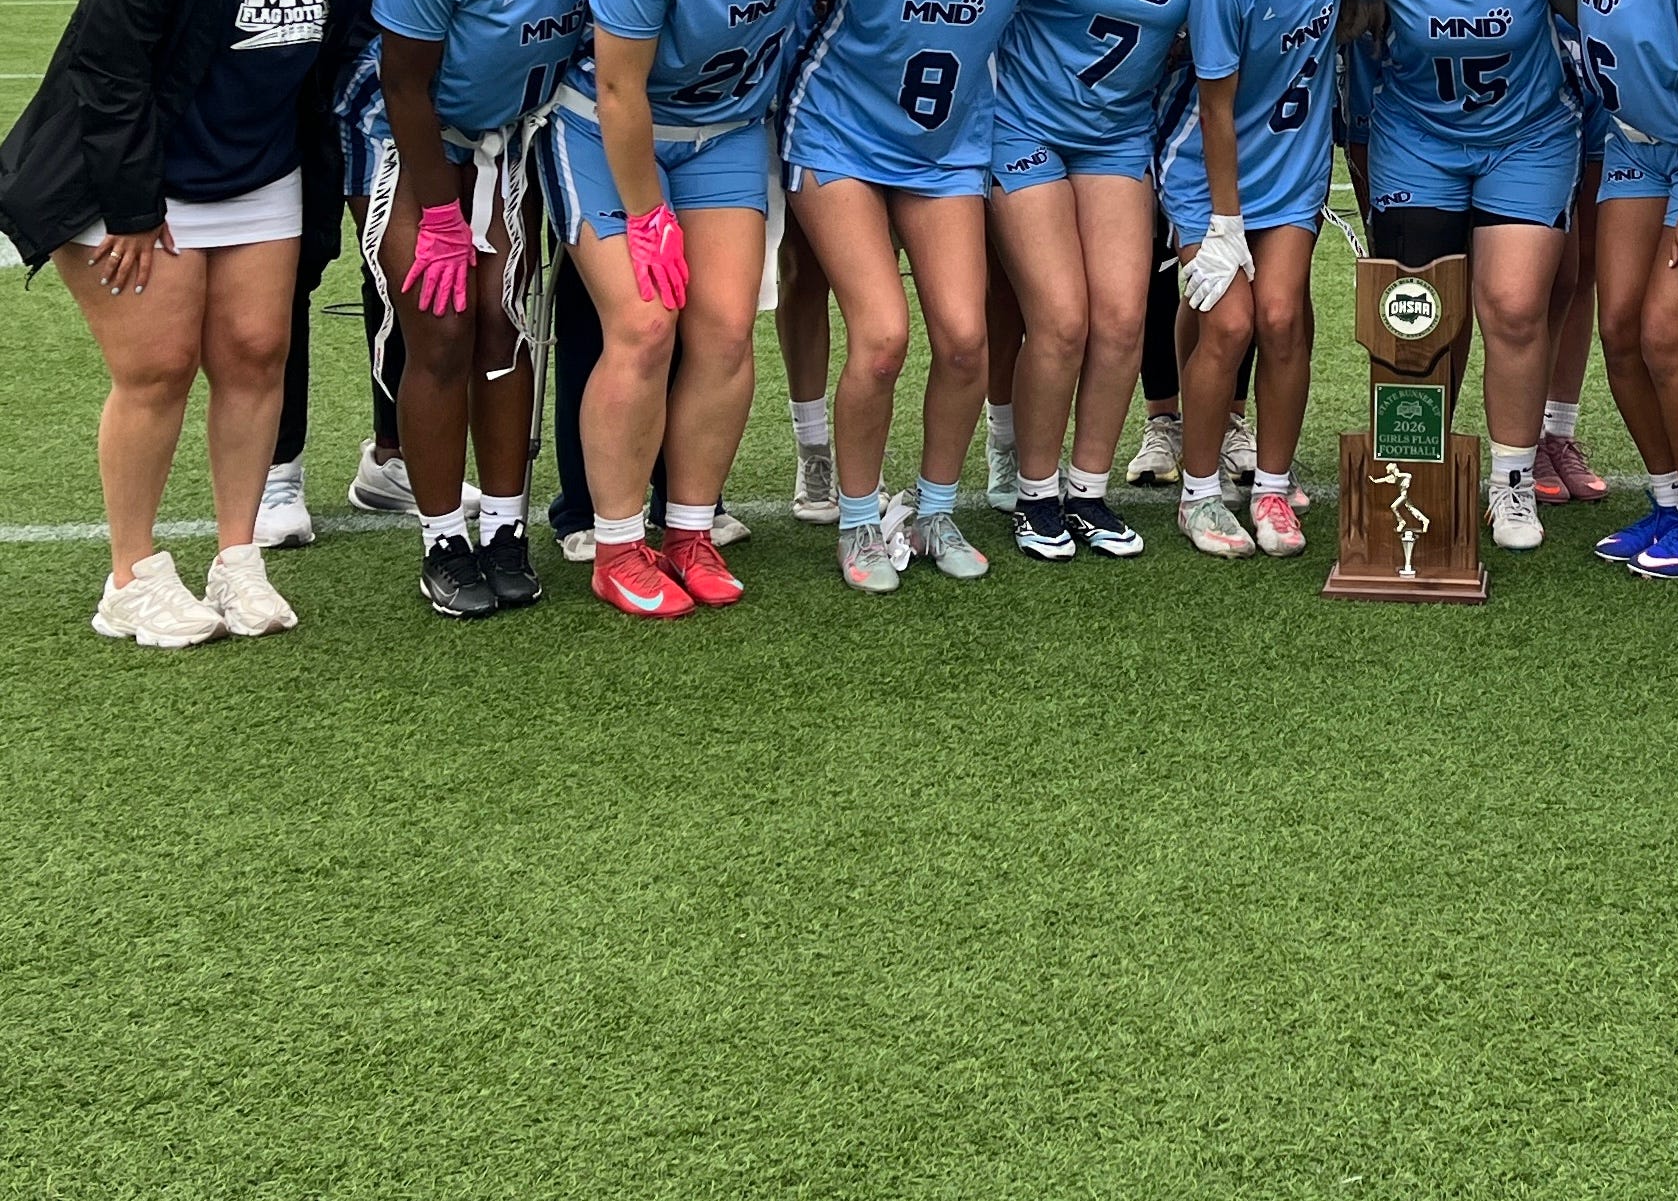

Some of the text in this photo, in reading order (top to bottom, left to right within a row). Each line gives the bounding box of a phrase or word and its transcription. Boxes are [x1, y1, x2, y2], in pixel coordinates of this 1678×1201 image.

[239, 7, 283, 24] FLAG
[1428, 15, 1509, 40] MND
[520, 11, 583, 47] MND
[1280, 14, 1331, 55] MND
[1075, 13, 1142, 90] 7
[898, 49, 961, 132] 8
[1432, 51, 1513, 114] 15
[1267, 55, 1320, 136] 6
[1004, 149, 1049, 174] MND
[1607, 169, 1643, 182] MND
[1390, 300, 1431, 316] OHSAA
[1393, 420, 1426, 433] 2026
[1379, 434, 1440, 445] GIRLS FLAG
[1379, 444, 1438, 456] FOOTBALL
